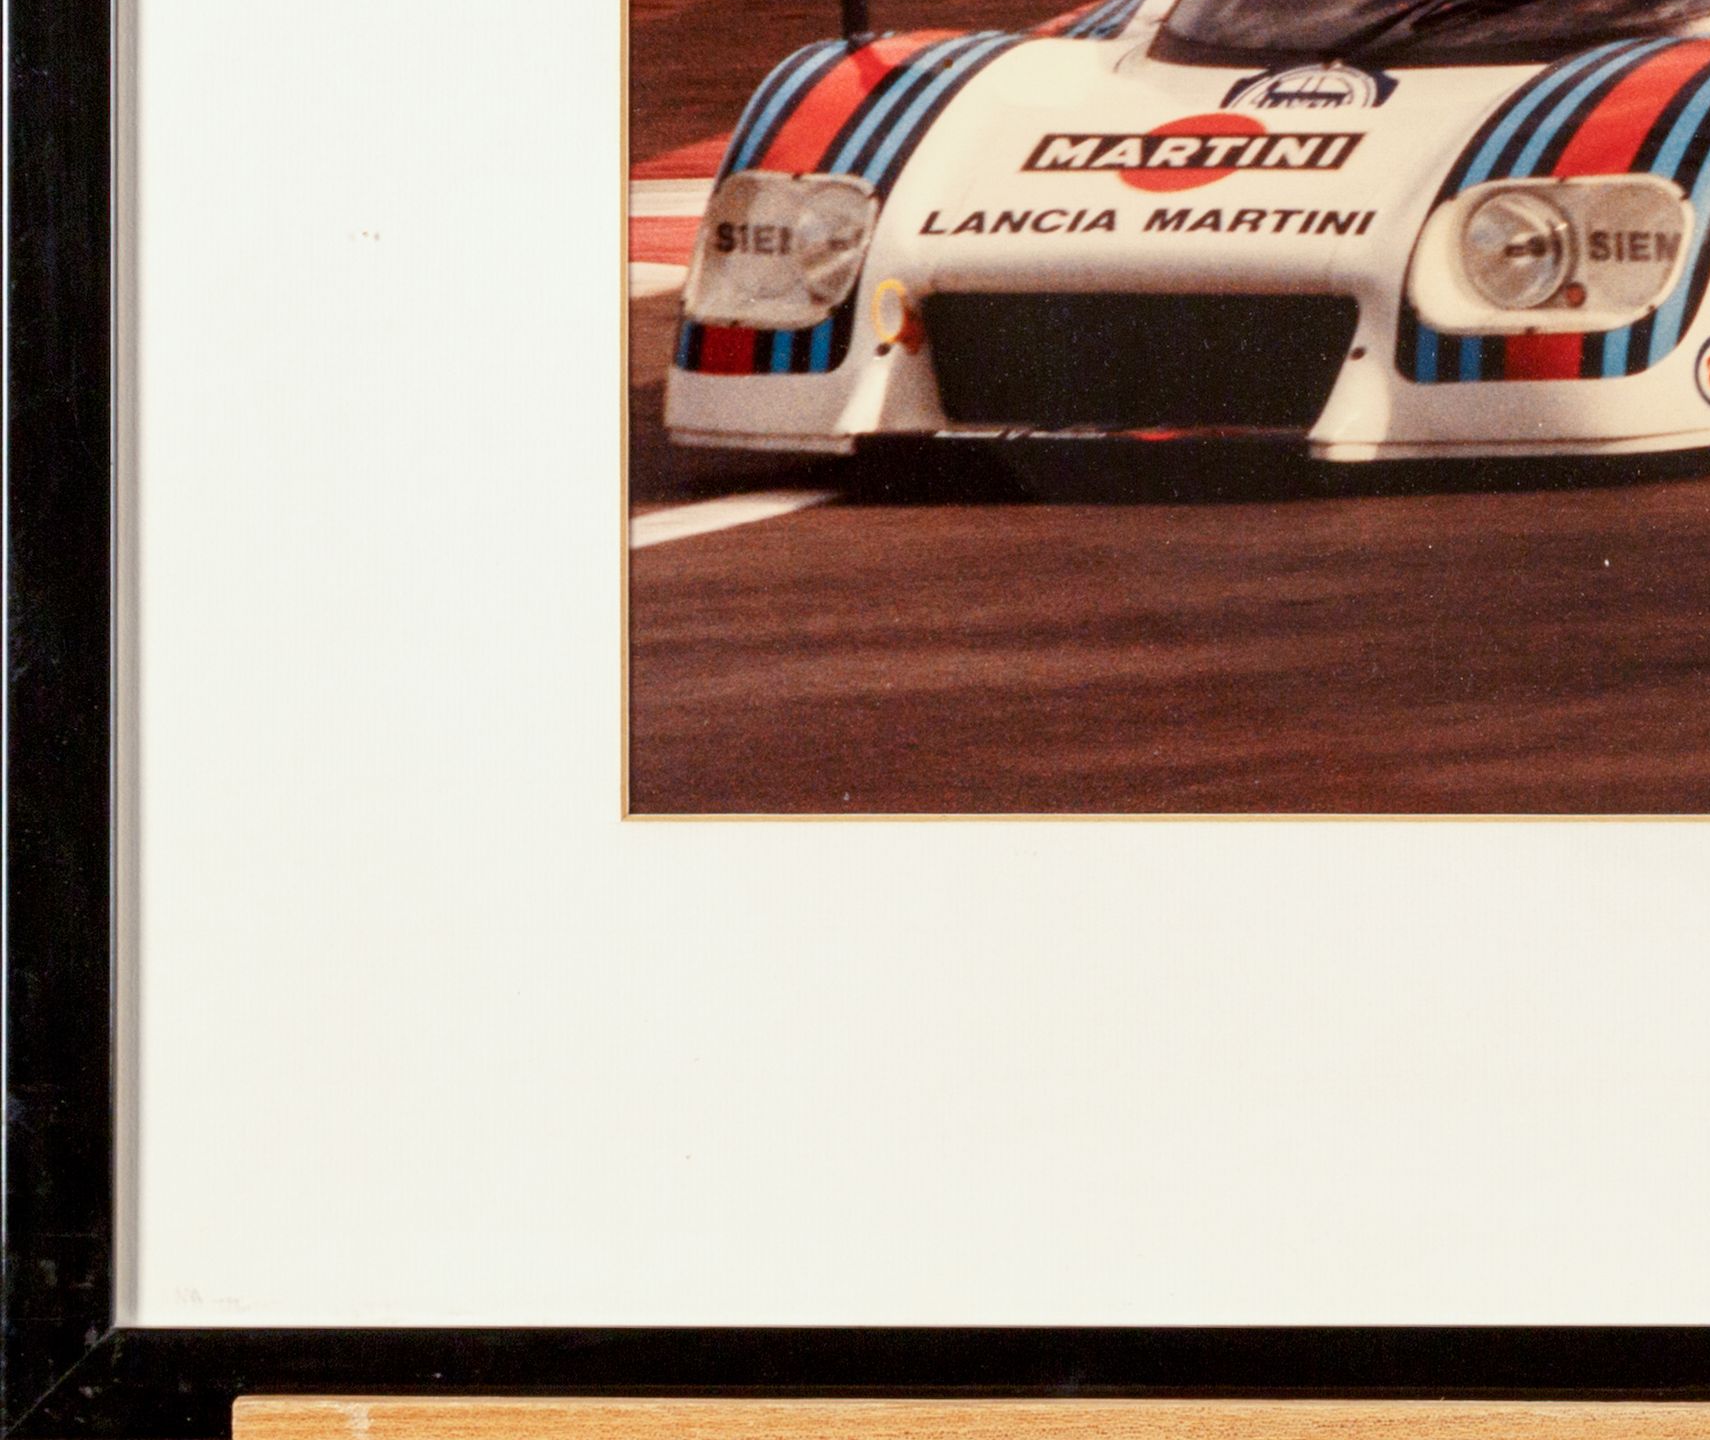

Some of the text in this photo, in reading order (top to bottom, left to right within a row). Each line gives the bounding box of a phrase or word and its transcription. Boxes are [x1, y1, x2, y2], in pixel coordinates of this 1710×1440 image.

[1033, 136, 1354, 169] MARTINI
[918, 208, 1379, 236] LANCIA MARTINI
